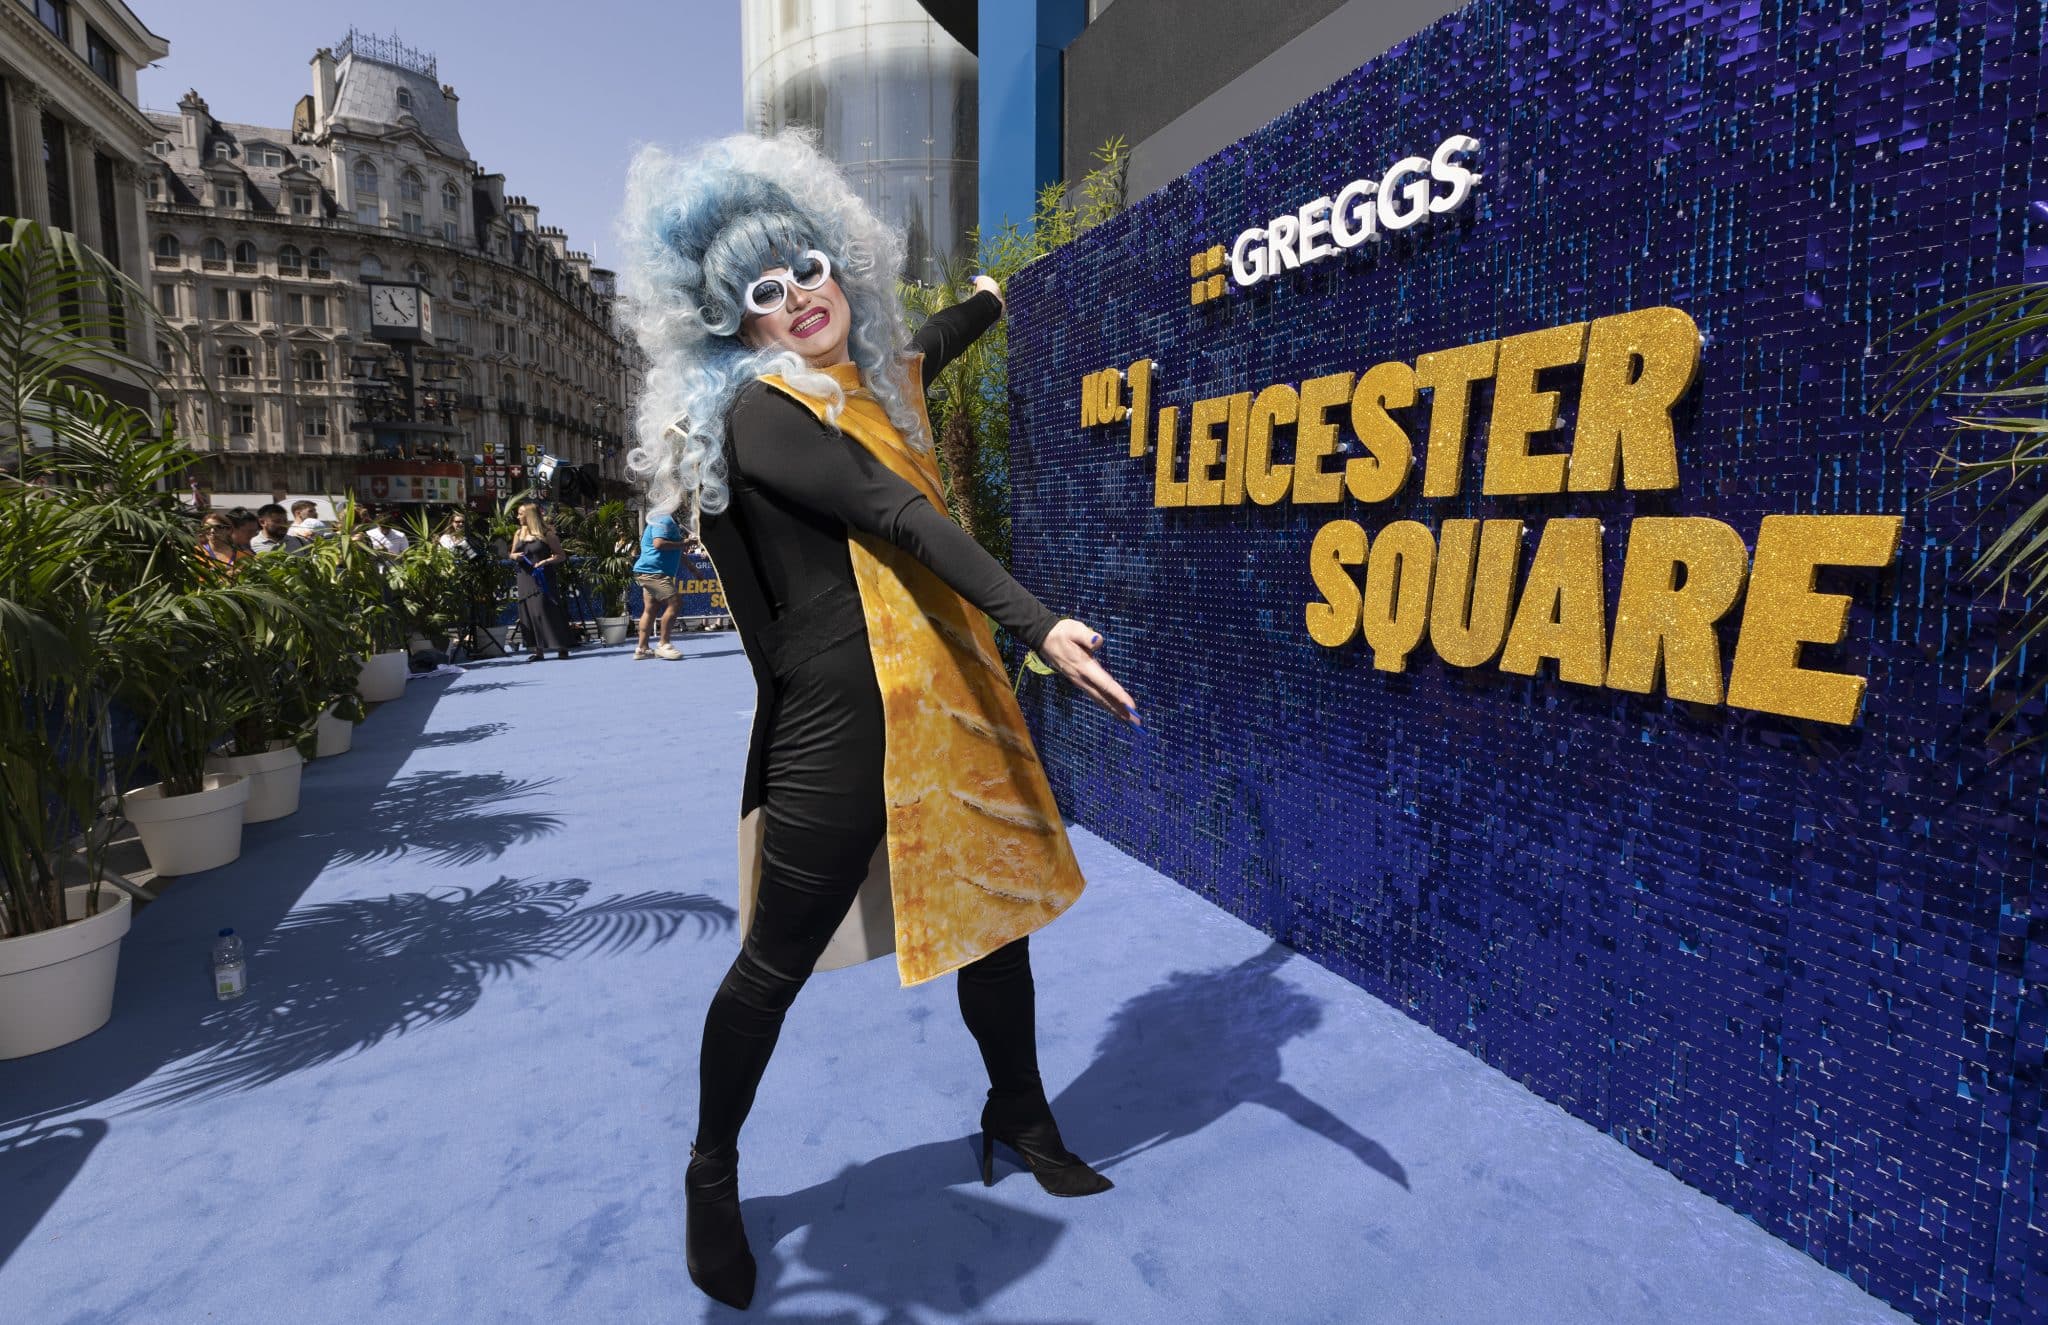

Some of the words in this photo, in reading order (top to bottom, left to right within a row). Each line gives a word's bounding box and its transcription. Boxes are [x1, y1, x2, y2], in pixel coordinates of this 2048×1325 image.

[1231, 134, 1482, 287] GREGGS
[1154, 306, 1703, 508] LEICESTER
[1306, 514, 1903, 726] SQUARE
